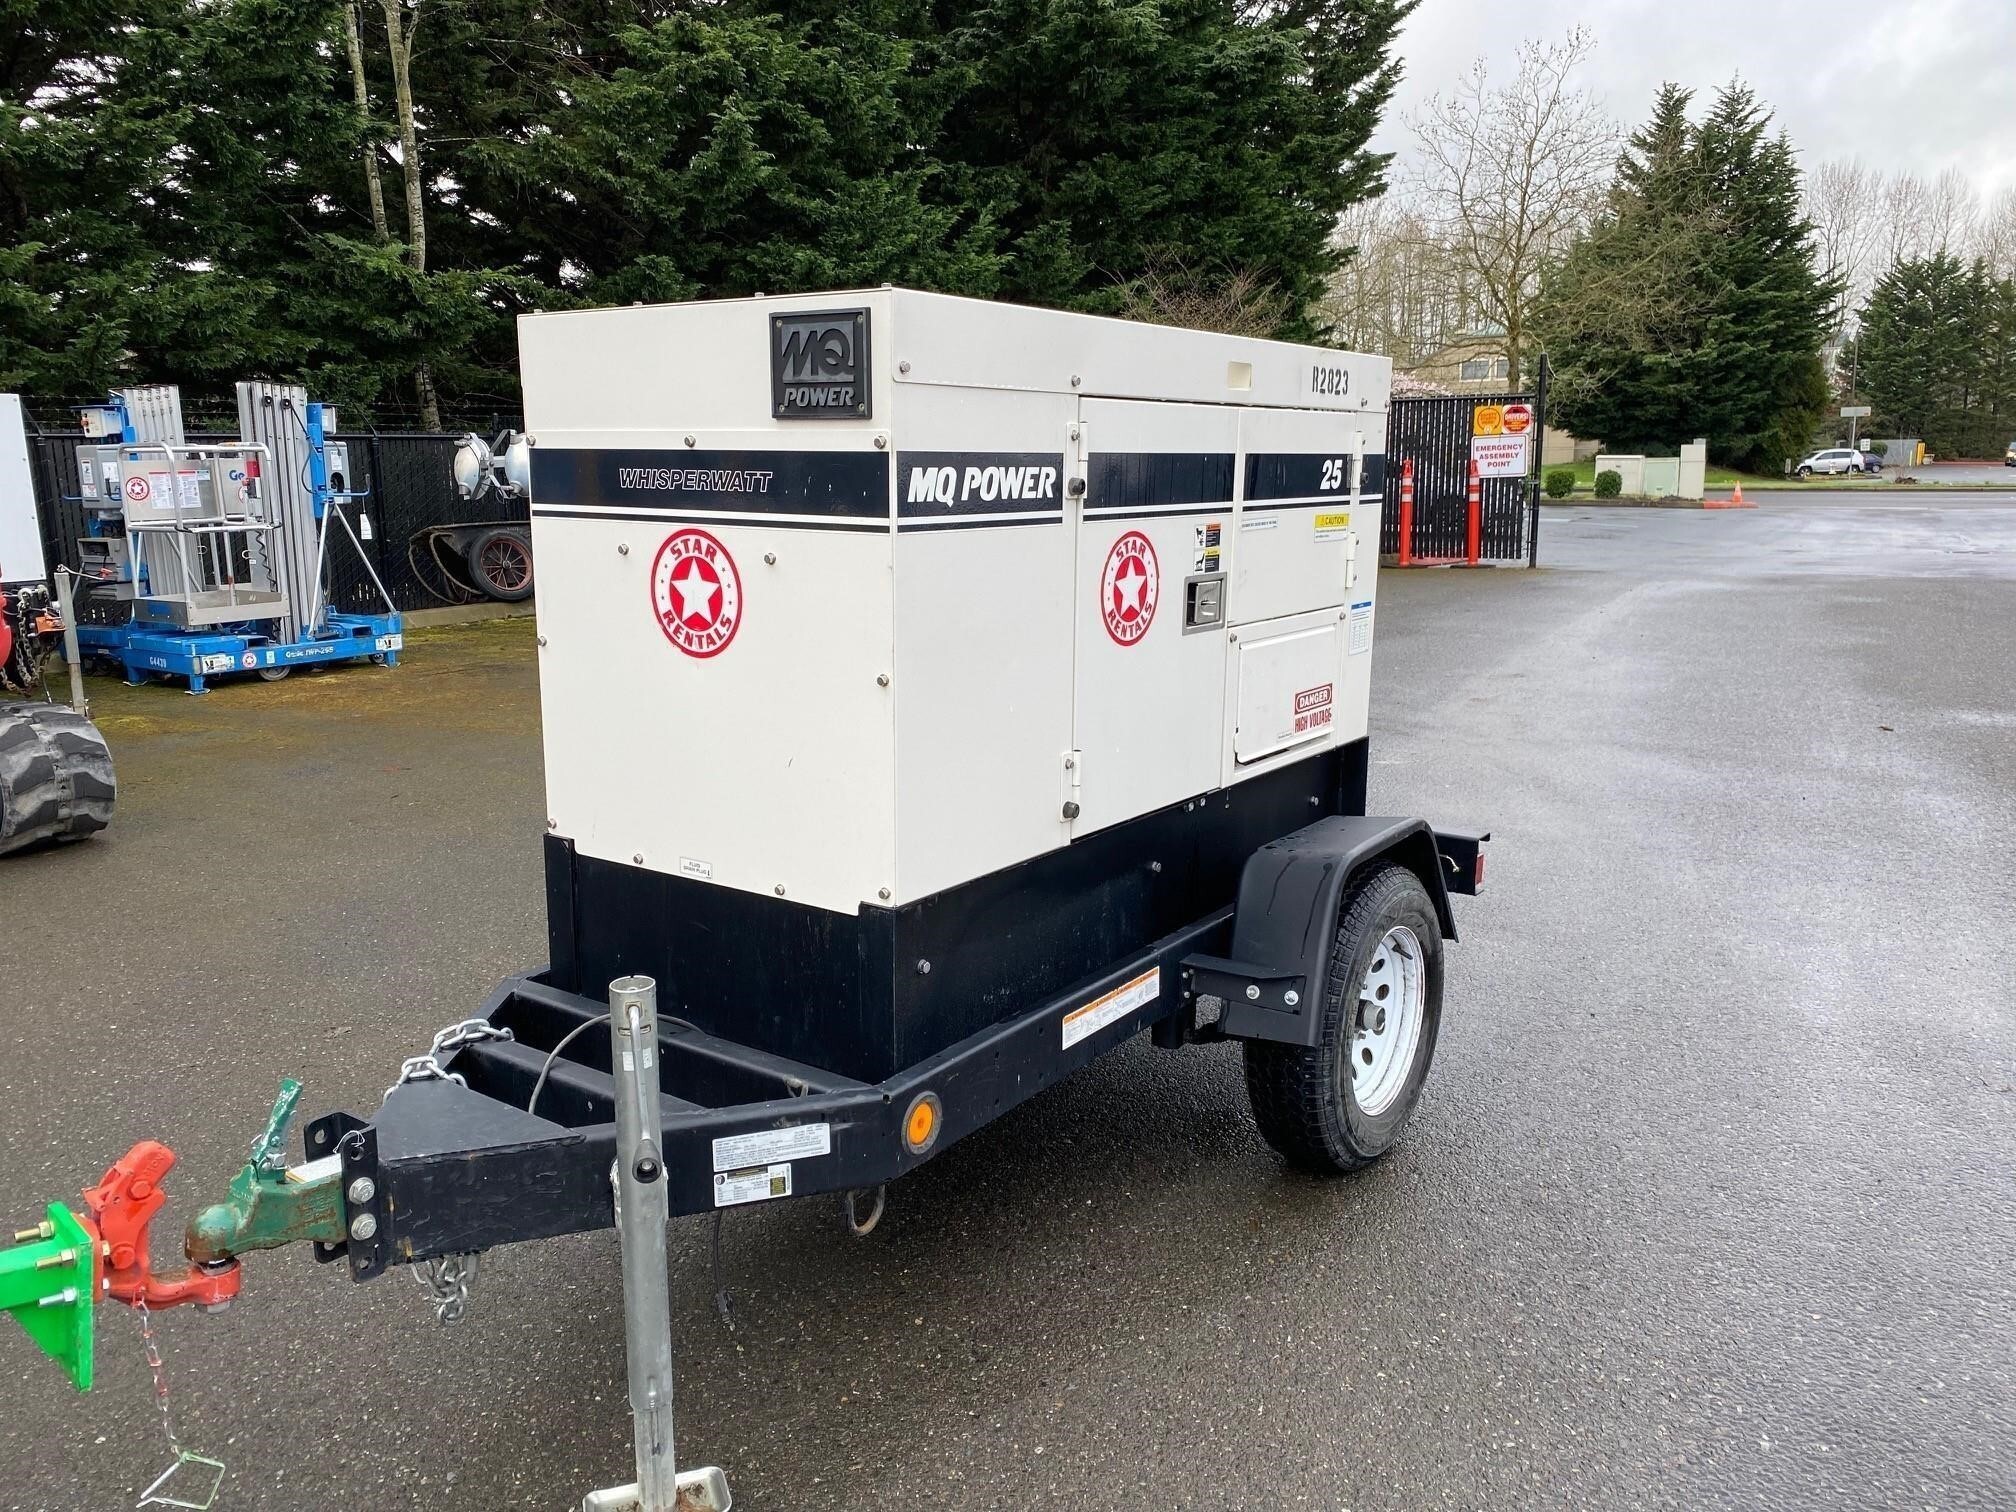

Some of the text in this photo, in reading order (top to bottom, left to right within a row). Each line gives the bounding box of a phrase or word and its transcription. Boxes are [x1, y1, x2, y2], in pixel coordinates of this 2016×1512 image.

[781, 328, 853, 376] MQ
[1312, 366, 1349, 395] R2823
[784, 386, 855, 407] POWER
[1476, 444, 1523, 452] EMERGENCY
[1479, 452, 1519, 460] ASSEMBLY
[619, 468, 773, 492] WHISPERWATT
[907, 466, 1056, 508] MQ POWER
[1320, 459, 1343, 490] 25
[1325, 516, 1345, 526] CAUTION
[670, 538, 717, 565] STAR
[1116, 539, 1147, 562] STAR
[662, 610, 732, 650] RENTALS
[1107, 601, 1153, 638] RENTALS
[1299, 690, 1328, 708] DANGER
[1295, 708, 1332, 733] HIGH VOLTAGE
